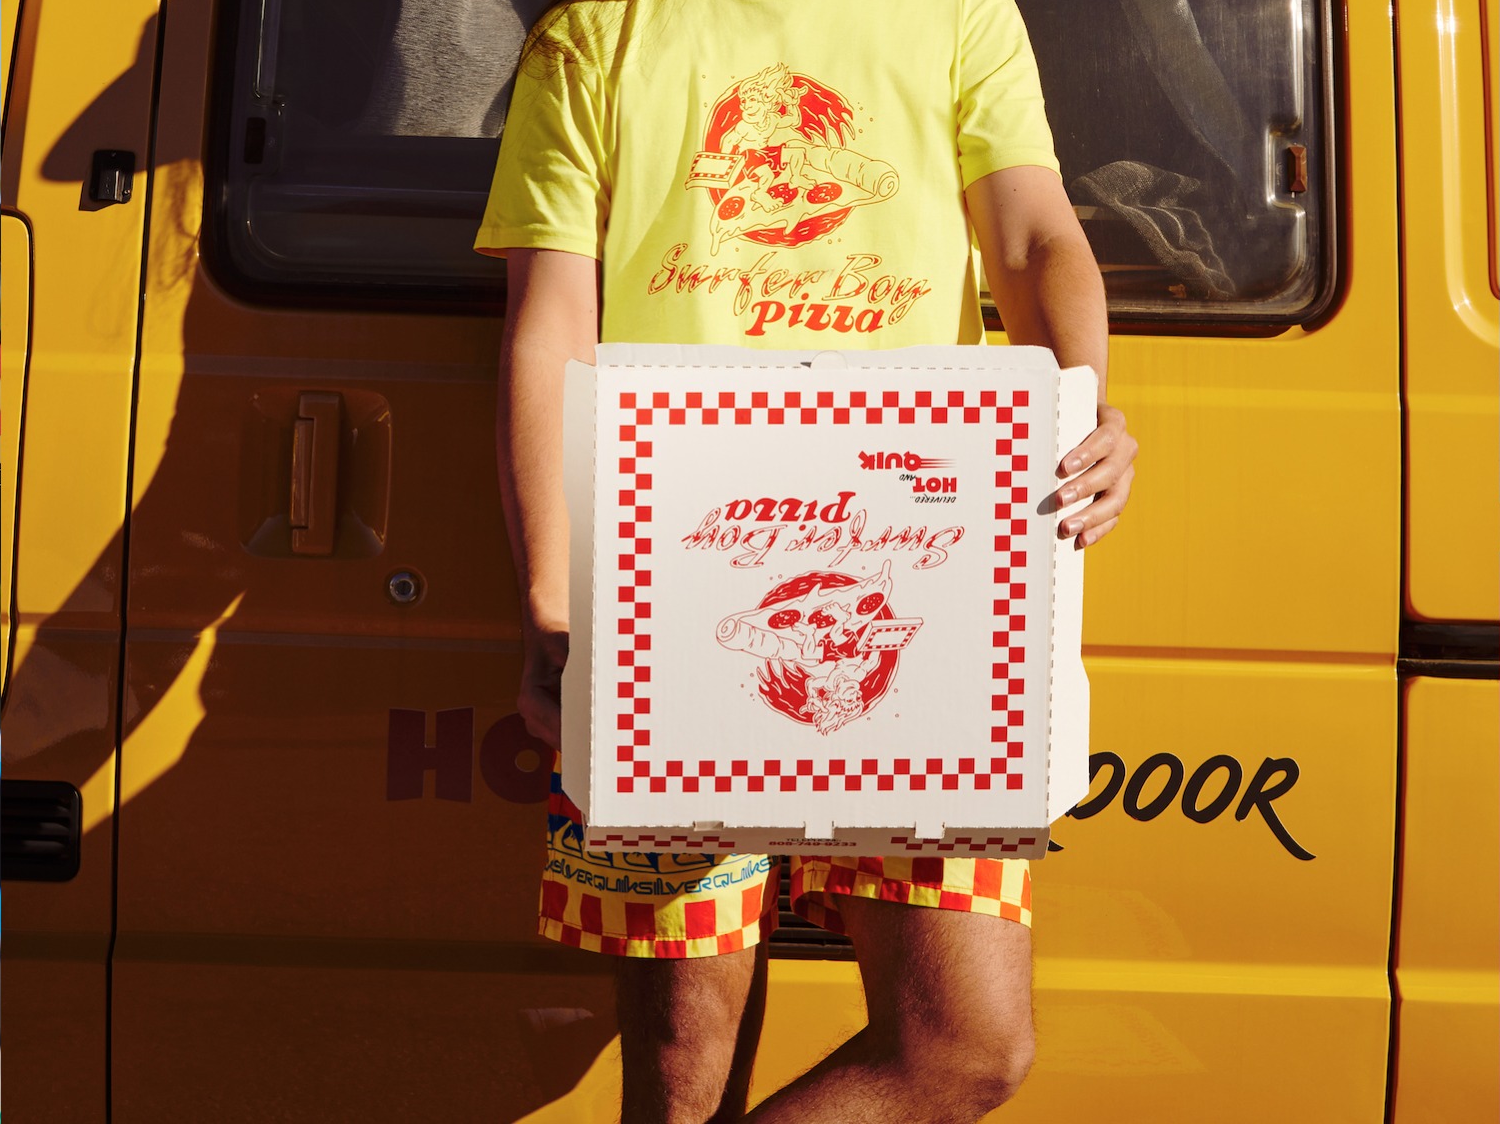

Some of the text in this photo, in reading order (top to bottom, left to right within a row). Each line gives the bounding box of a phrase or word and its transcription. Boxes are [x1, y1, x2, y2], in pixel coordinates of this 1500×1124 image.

[647, 243, 932, 326] Surfer Boy
[858, 450, 922, 472] QUIK
[898, 474, 957, 493] HOT AND
[681, 508, 965, 569] Surfer Boy
[1065, 752, 1317, 861] DOOR
